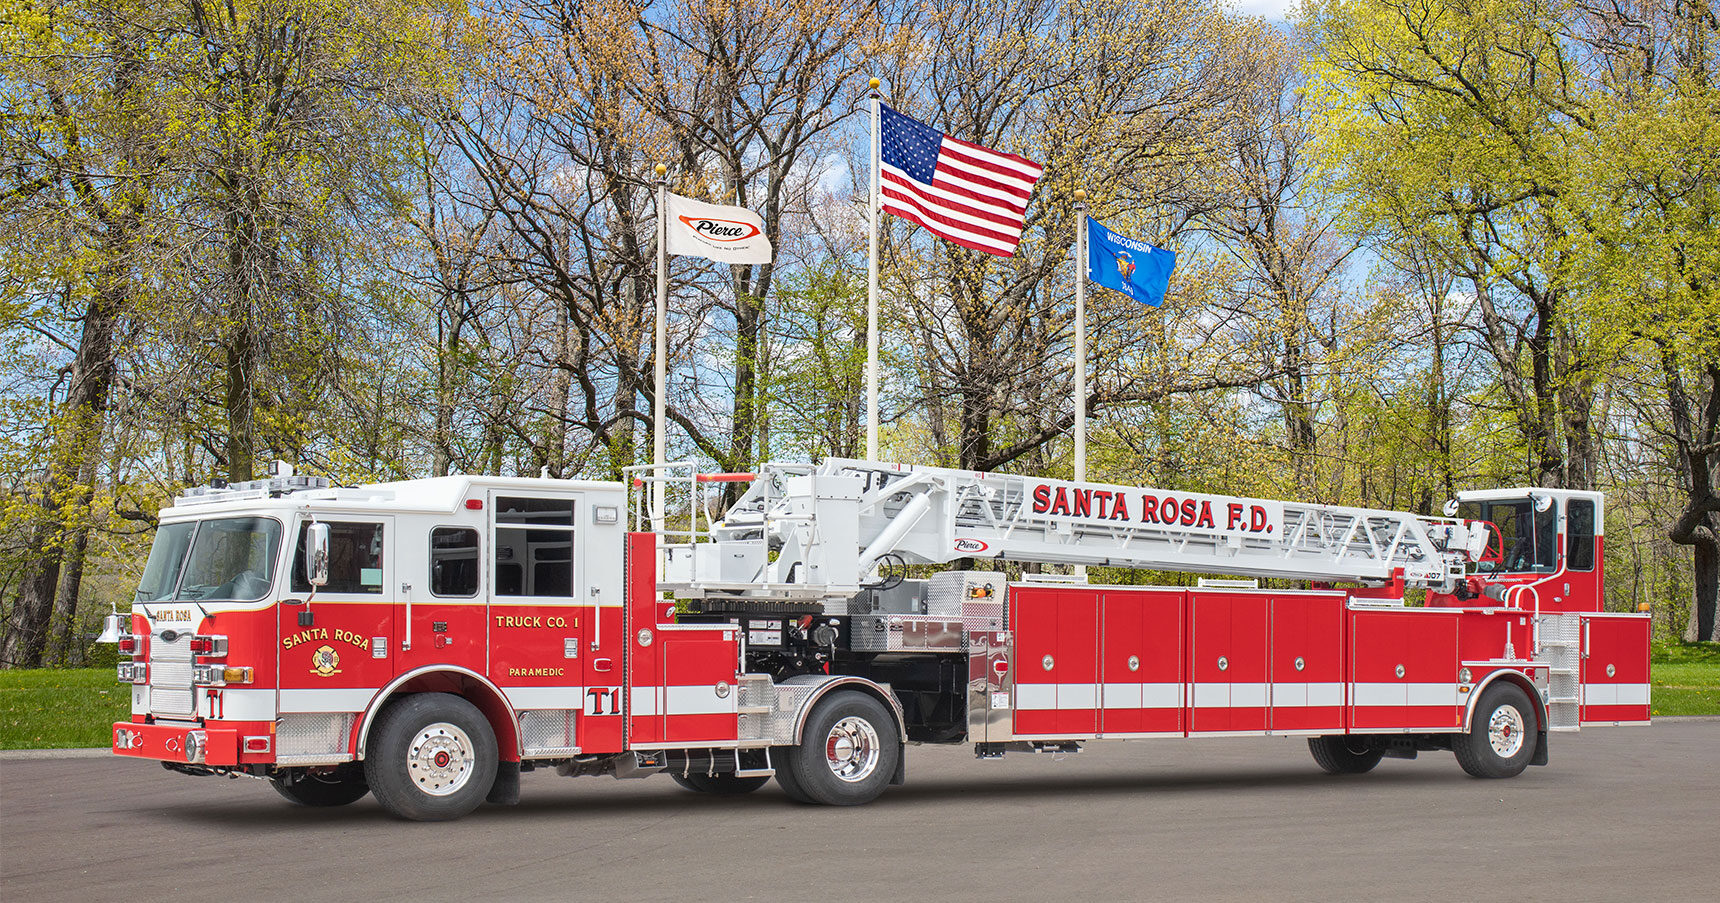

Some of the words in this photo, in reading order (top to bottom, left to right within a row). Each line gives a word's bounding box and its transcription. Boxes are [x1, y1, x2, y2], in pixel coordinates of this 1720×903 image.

[696, 220, 743, 236] Pierce
[1107, 232, 1152, 254] WISCONSIN
[1032, 484, 1130, 522] SANTA
[1141, 494, 1216, 529] ROSA
[1227, 502, 1274, 534] F.D.
[957, 540, 980, 549] Pierce
[156, 609, 174, 622] SANTA
[175, 609, 192, 622] ROSA
[495, 615, 542, 628] TRUCK
[546, 616, 568, 628] CO.
[573, 617, 579, 628] 1
[282, 628, 329, 650] SANTA
[334, 628, 369, 651] ROSA
[508, 668, 564, 677] PARAMEDIC
[206, 689, 224, 719] T1
[586, 687, 620, 715] T1
